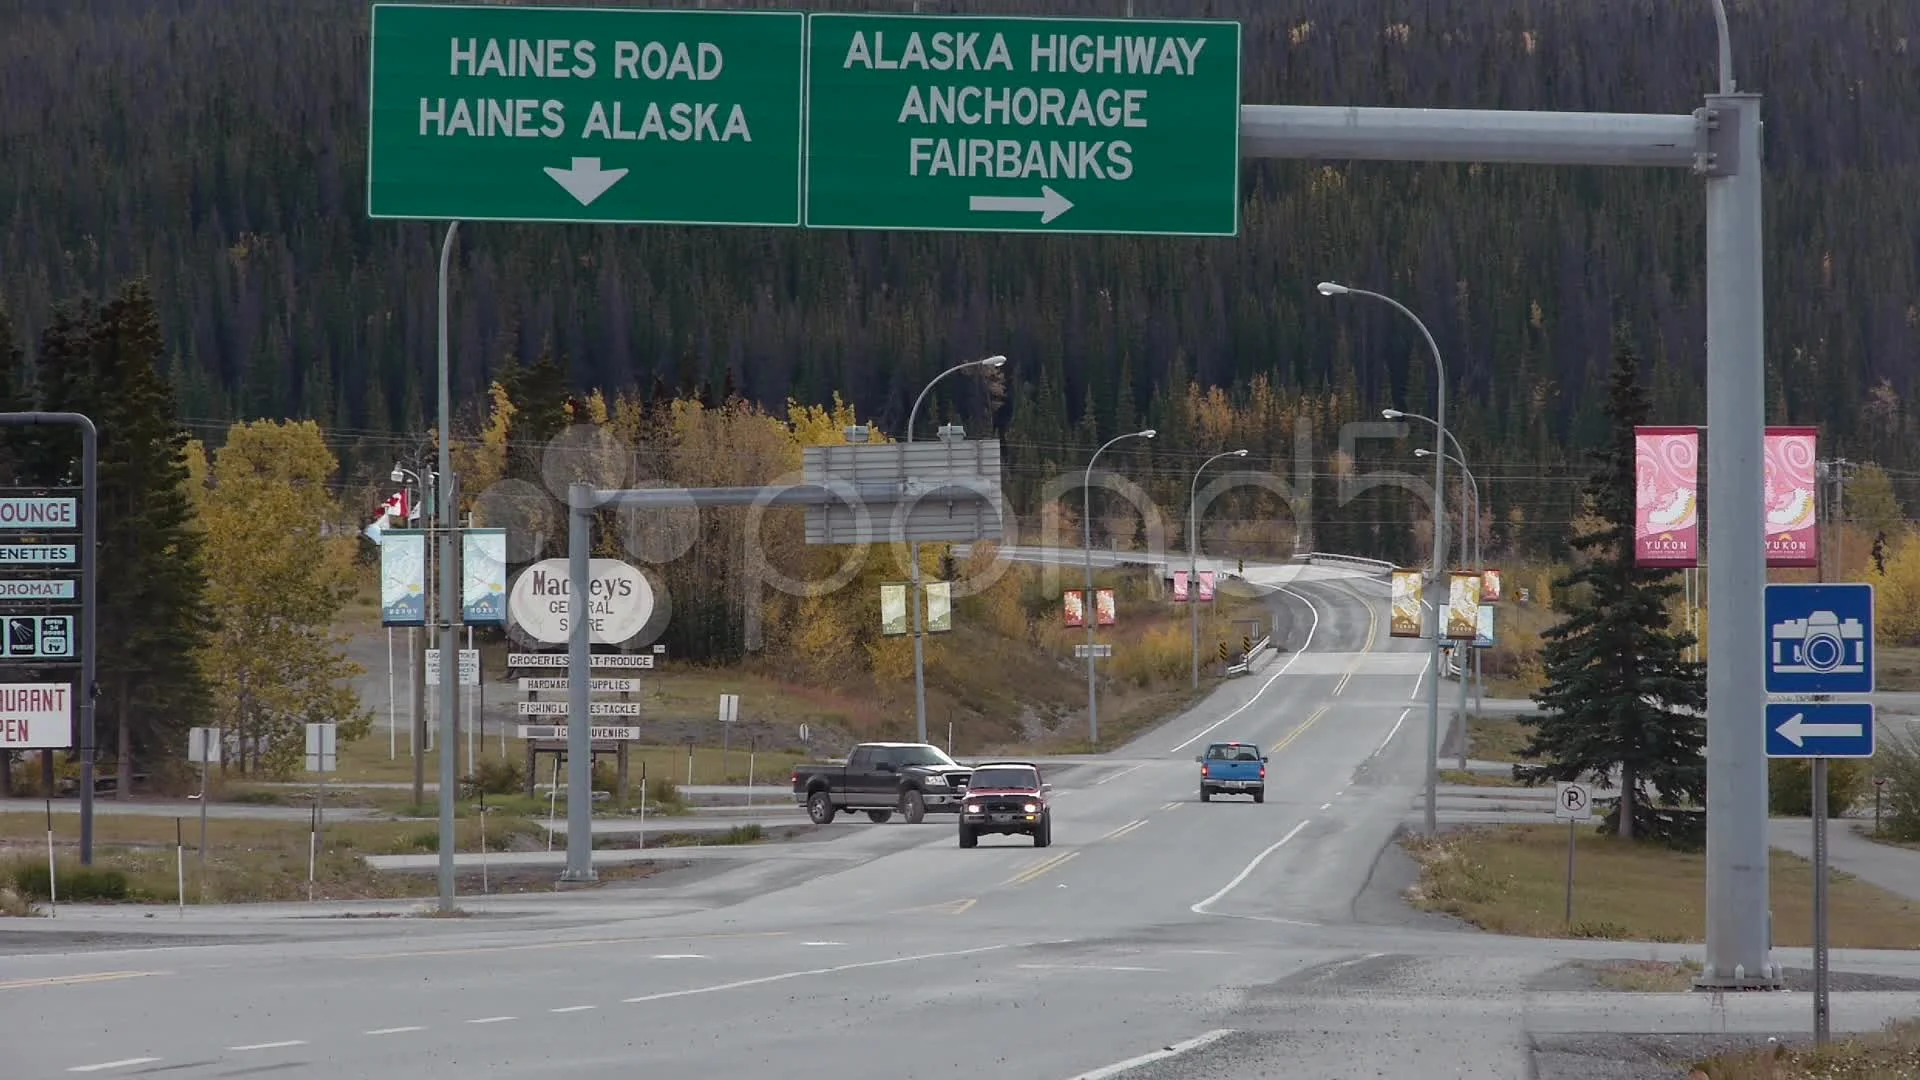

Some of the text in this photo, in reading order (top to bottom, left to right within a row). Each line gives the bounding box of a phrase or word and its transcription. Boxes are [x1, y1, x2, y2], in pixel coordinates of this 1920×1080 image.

[450, 37, 723, 81] HAINES ROAD
[843, 31, 1207, 75] ALASKA HIGHWAY
[898, 85, 1148, 128] ANCHORAGE
[419, 97, 752, 142] HAINES ALASKA
[909, 138, 1134, 180] FAIRBANKS
[1645, 541, 1687, 550] YUKON
[1765, 541, 1807, 550] YUKON
[532, 570, 632, 600] Maey's
[549, 601, 614, 614] GERAL
[559, 618, 604, 631] SRE
[509, 655, 570, 667] GROCERIES
[527, 679, 570, 690] HARDWAR
[520, 703, 557, 713] FISHING
[591, 728, 630, 738] UVENIRS
